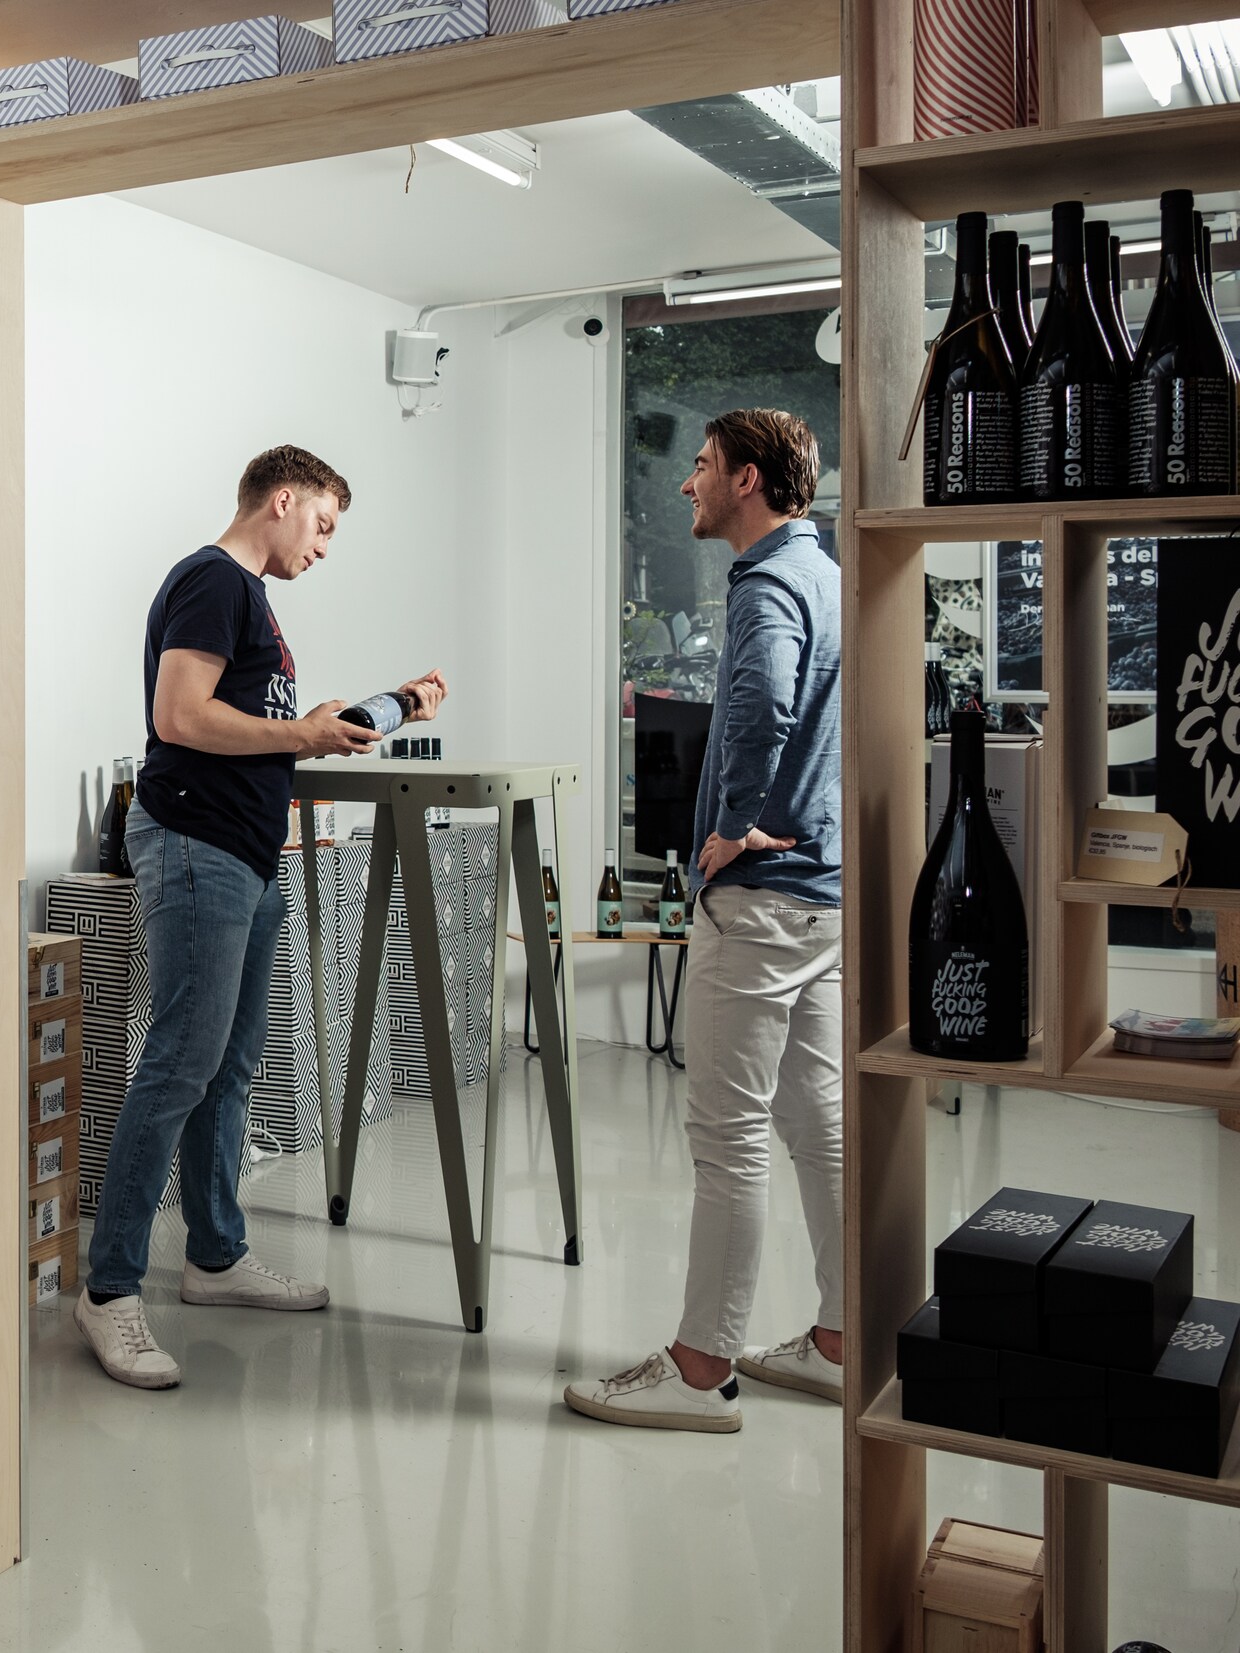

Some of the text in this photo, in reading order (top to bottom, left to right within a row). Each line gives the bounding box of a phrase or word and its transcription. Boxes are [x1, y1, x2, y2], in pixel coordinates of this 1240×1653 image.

[1064, 383, 1082, 488] 50 Reasons
[1167, 377, 1185, 484] 50 Reasons
[947, 392, 964, 493] 50 Reasons
[937, 959, 989, 982] JUST
[932, 979, 986, 998] FUCKING
[932, 997, 986, 1017] GOOD
[940, 1015, 988, 1036] WINE
